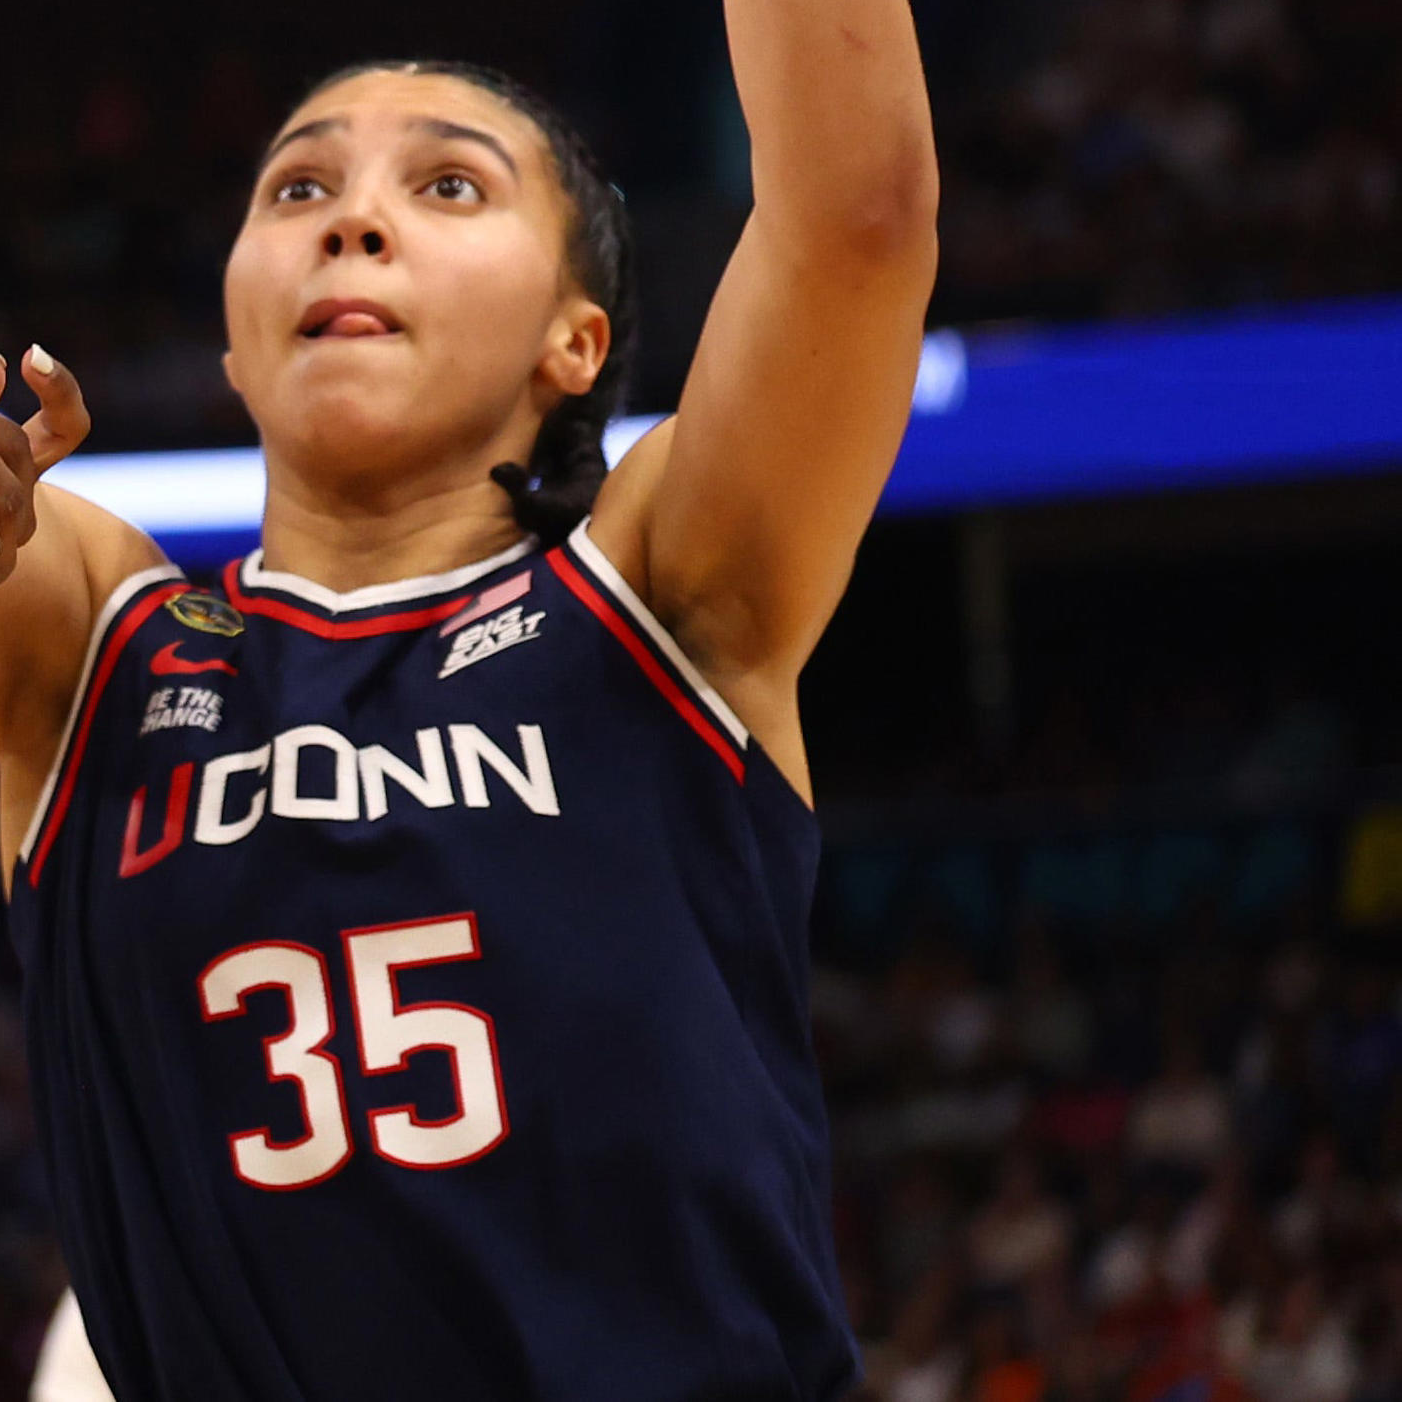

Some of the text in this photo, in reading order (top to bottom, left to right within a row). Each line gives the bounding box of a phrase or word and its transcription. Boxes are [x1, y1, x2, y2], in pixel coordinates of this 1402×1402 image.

[440, 611, 546, 676] EAST
[452, 605, 525, 653] BIG
[177, 685, 224, 712] THE
[117, 723, 560, 878] UCONN
[196, 911, 511, 1192] 35
